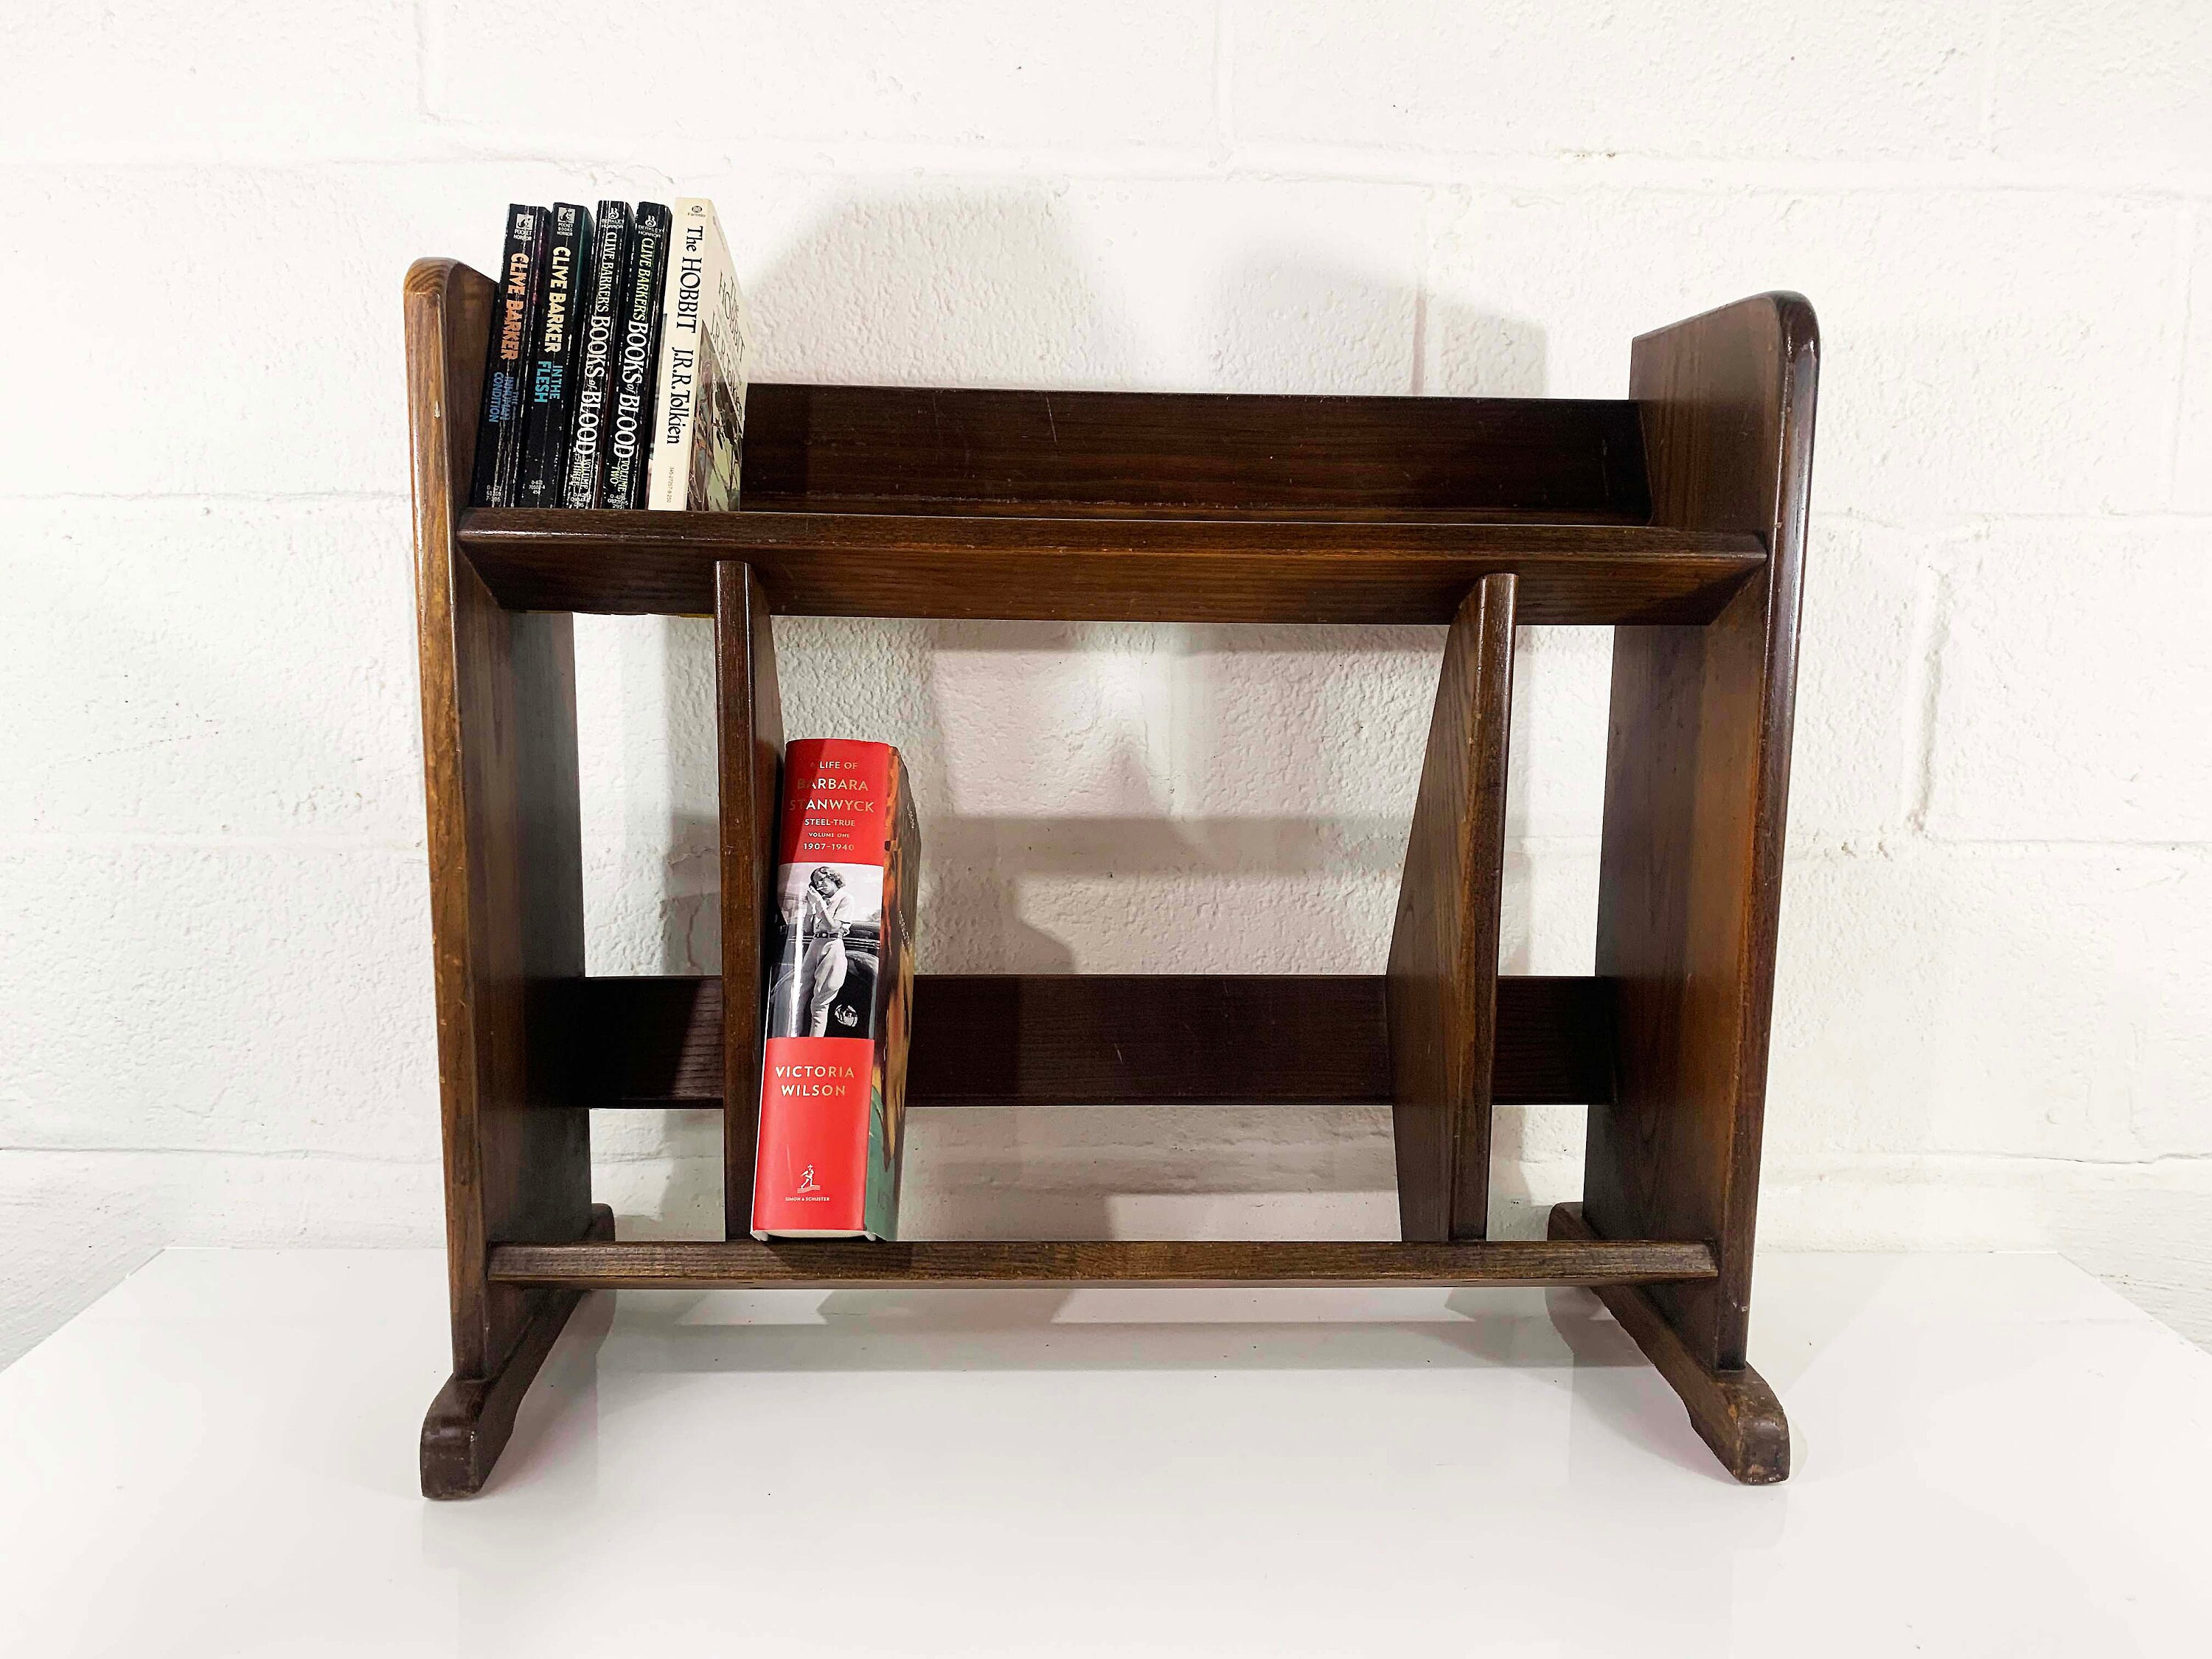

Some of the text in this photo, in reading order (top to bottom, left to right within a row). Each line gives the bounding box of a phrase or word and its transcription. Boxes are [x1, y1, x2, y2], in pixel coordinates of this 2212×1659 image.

[602, 232, 618, 260] CLIVE
[639, 237, 655, 268] CLIVE
[686, 226, 703, 252] The
[501, 253, 529, 360] CLIVE BARKER
[544, 246, 571, 353] CLIVE BARKER
[676, 257, 703, 333] HOBBIT
[585, 316, 611, 378] BOOKS
[622, 320, 649, 384] BOOKS
[489, 372, 504, 422] CONDITION
[534, 361, 552, 403] FLESH
[549, 365, 563, 400] IN THE
[625, 383, 636, 394] of
[576, 391, 602, 455] BLOOD
[613, 392, 640, 458] BLOOD
[580, 459, 591, 490] VOLUME
[610, 466, 619, 484] TWO
[617, 460, 630, 492] VOLUME
[819, 761, 841, 769] LIFE
[844, 762, 858, 770] OF
[797, 778, 869, 791] BARBARA
[790, 799, 874, 813] STANWYCK
[804, 818, 856, 827] STEEL-TRUE
[775, 1065, 855, 1079] VICTORIA
[781, 1085, 846, 1096] WILSON
